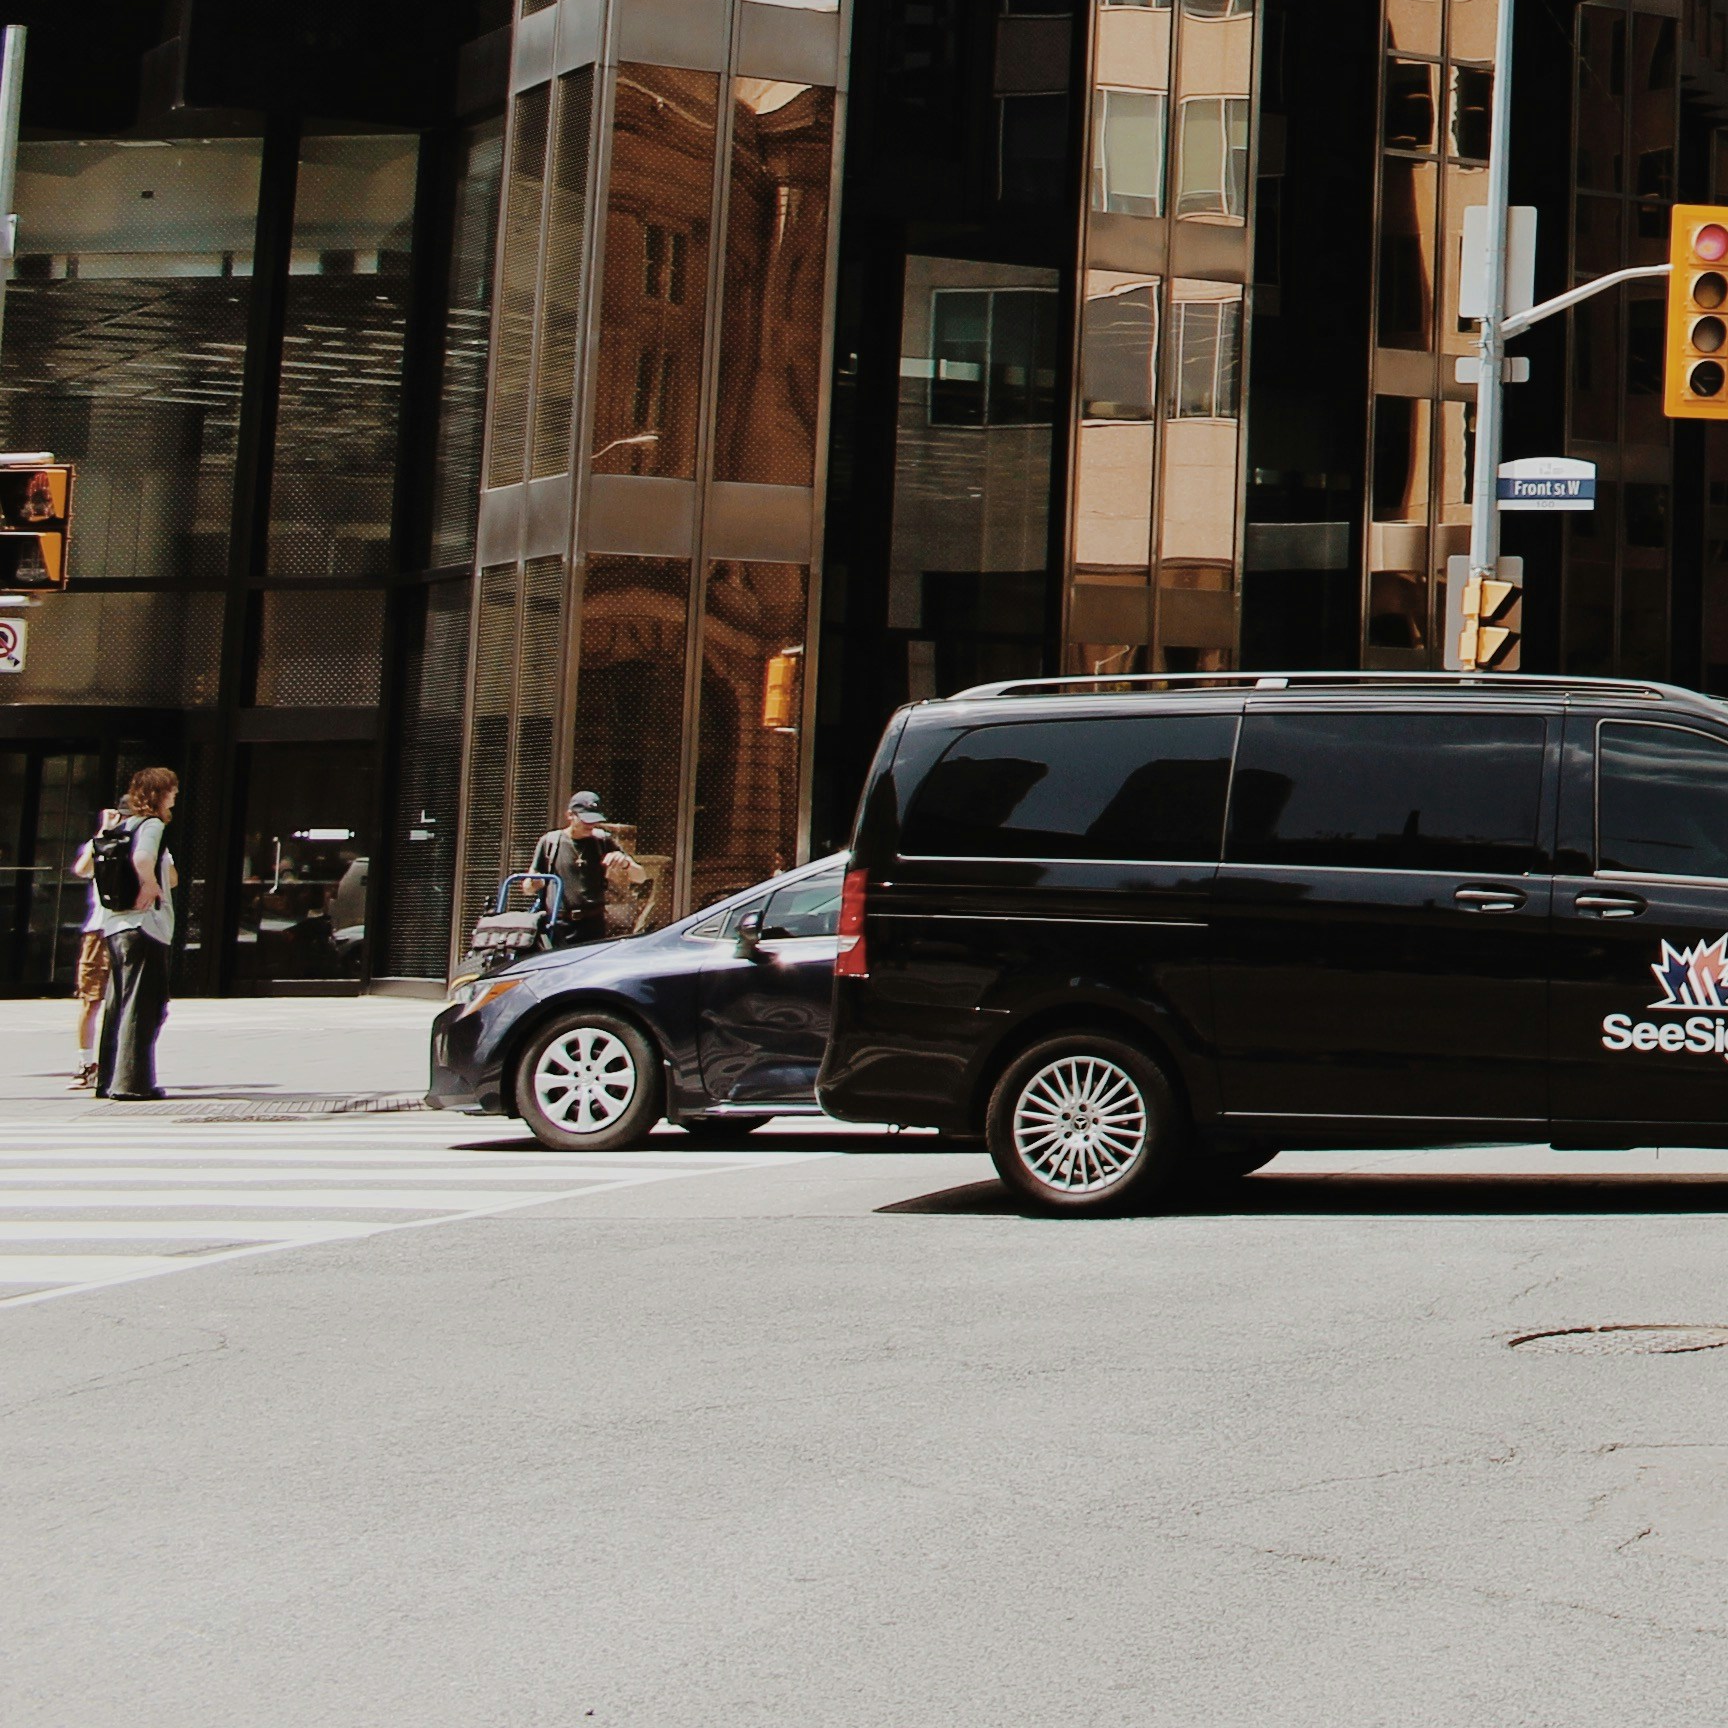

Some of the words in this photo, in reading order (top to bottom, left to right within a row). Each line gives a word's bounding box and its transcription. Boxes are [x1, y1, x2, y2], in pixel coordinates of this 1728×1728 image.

[1514, 480, 1552, 496] Front
[1554, 482, 1566, 497] St
[1567, 480, 1580, 496] W
